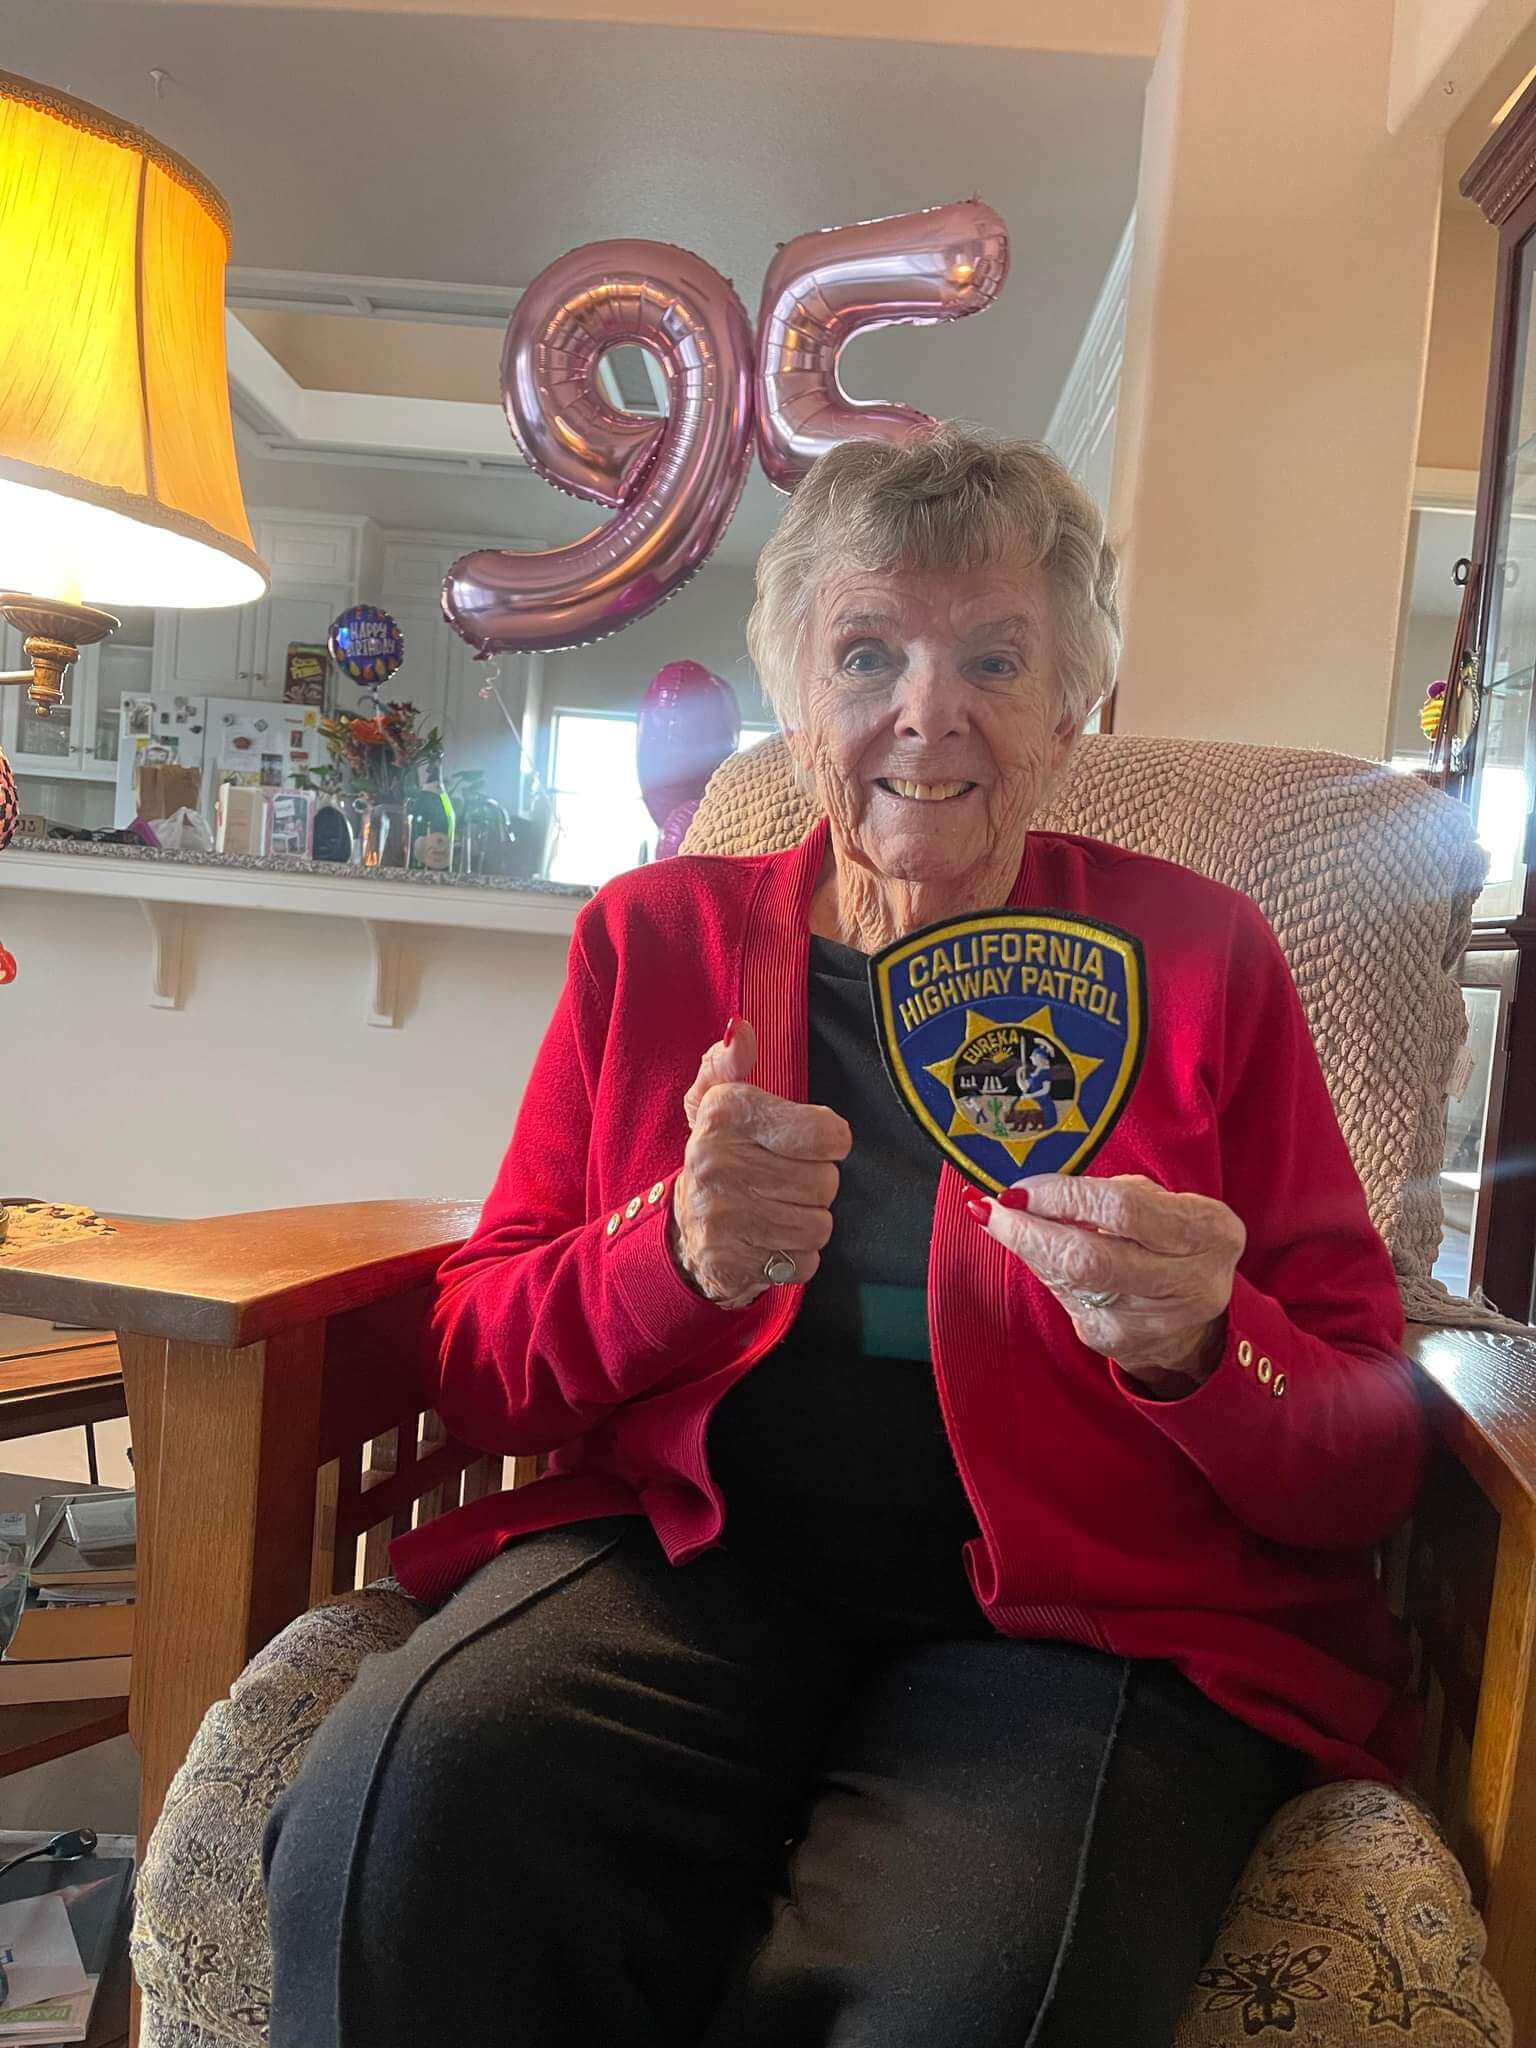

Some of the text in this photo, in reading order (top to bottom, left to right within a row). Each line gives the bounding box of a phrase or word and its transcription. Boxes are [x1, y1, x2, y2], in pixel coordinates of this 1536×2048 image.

[350, 621, 387, 640] HAPPY
[908, 933, 1104, 989] CALIFORNIA
[898, 966, 1122, 1033] HIGHWAY PATROL
[962, 1029, 1021, 1066] EUREKA
